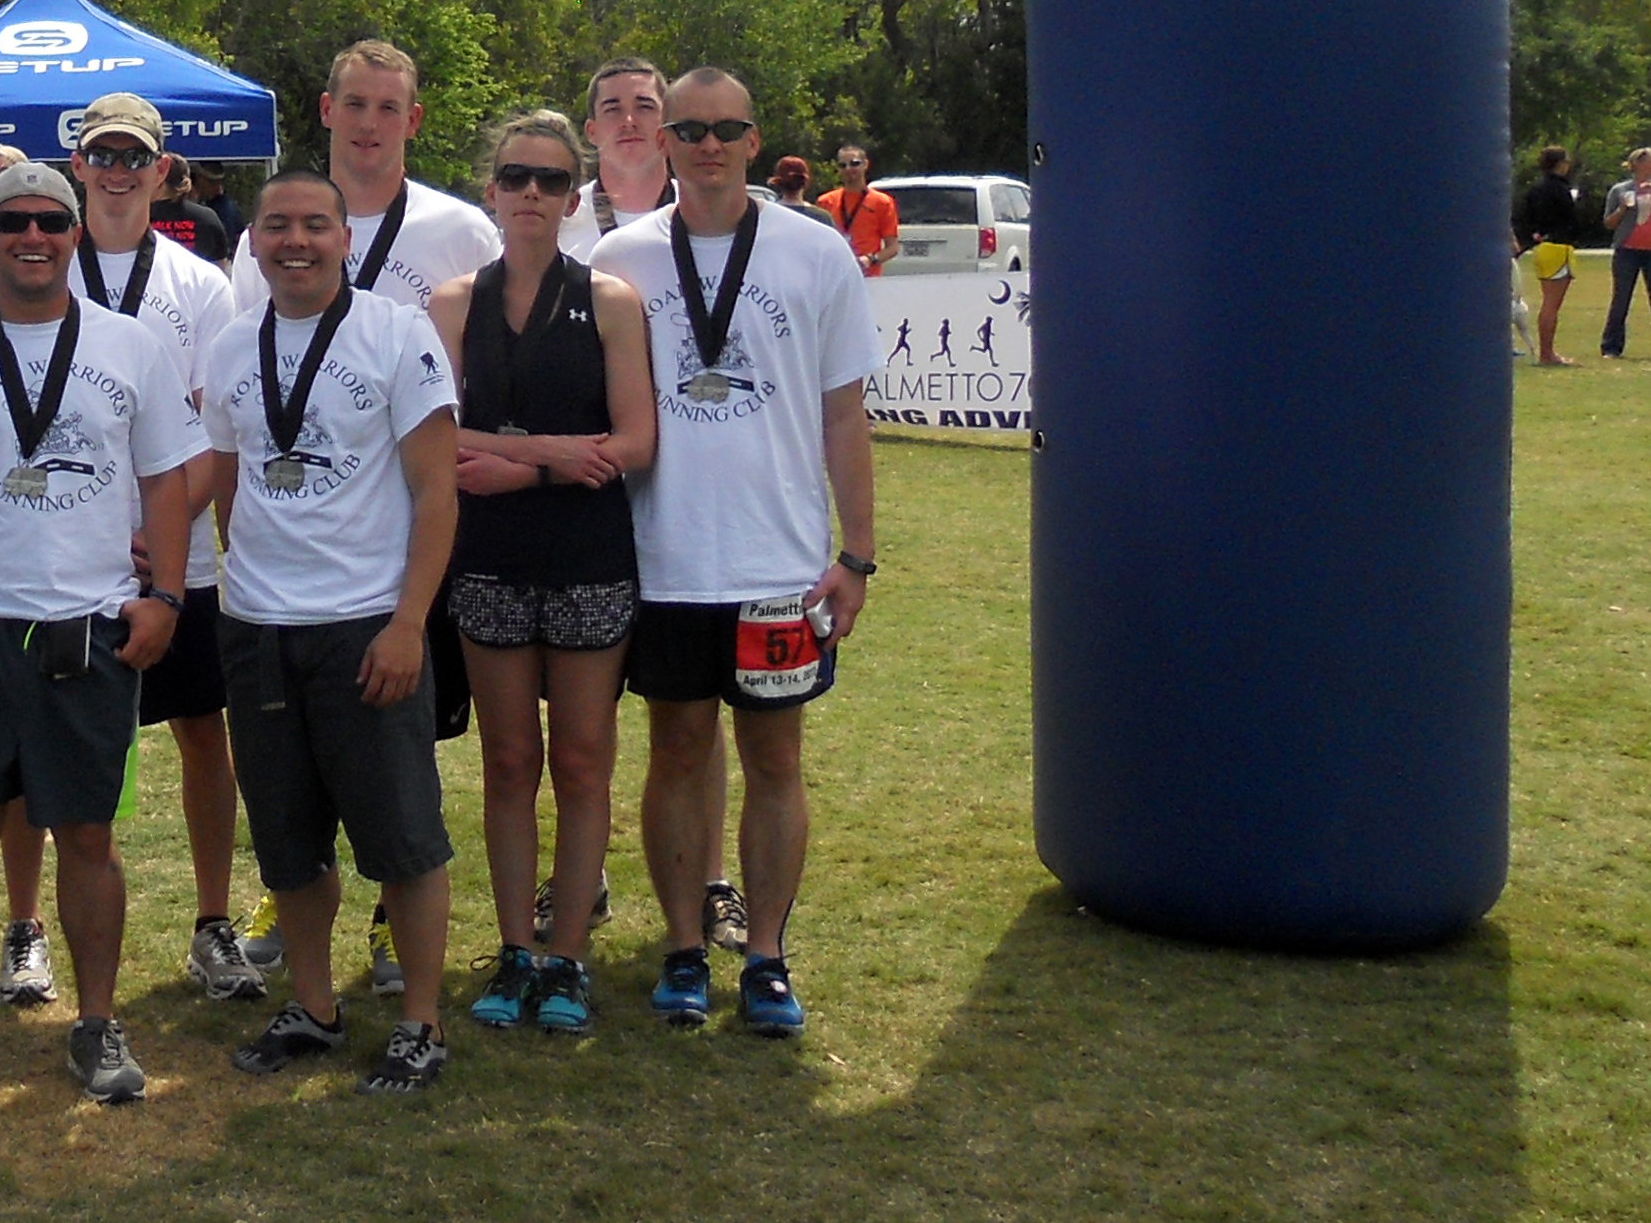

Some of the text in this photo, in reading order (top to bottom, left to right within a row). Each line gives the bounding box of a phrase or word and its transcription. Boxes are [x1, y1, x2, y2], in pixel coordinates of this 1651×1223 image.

[161, 120, 249, 137] ETUP
[345, 253, 432, 311] WRRIOR
[699, 276, 791, 339] WRIORS
[106, 287, 191, 348] WRRIORS
[27, 359, 129, 417] WRRIORS
[230, 354, 373, 412] ROA WRIORS
[312, 453, 362, 495] CLUB
[749, 603, 801, 617] Palmett
[766, 628, 805, 666] 57
